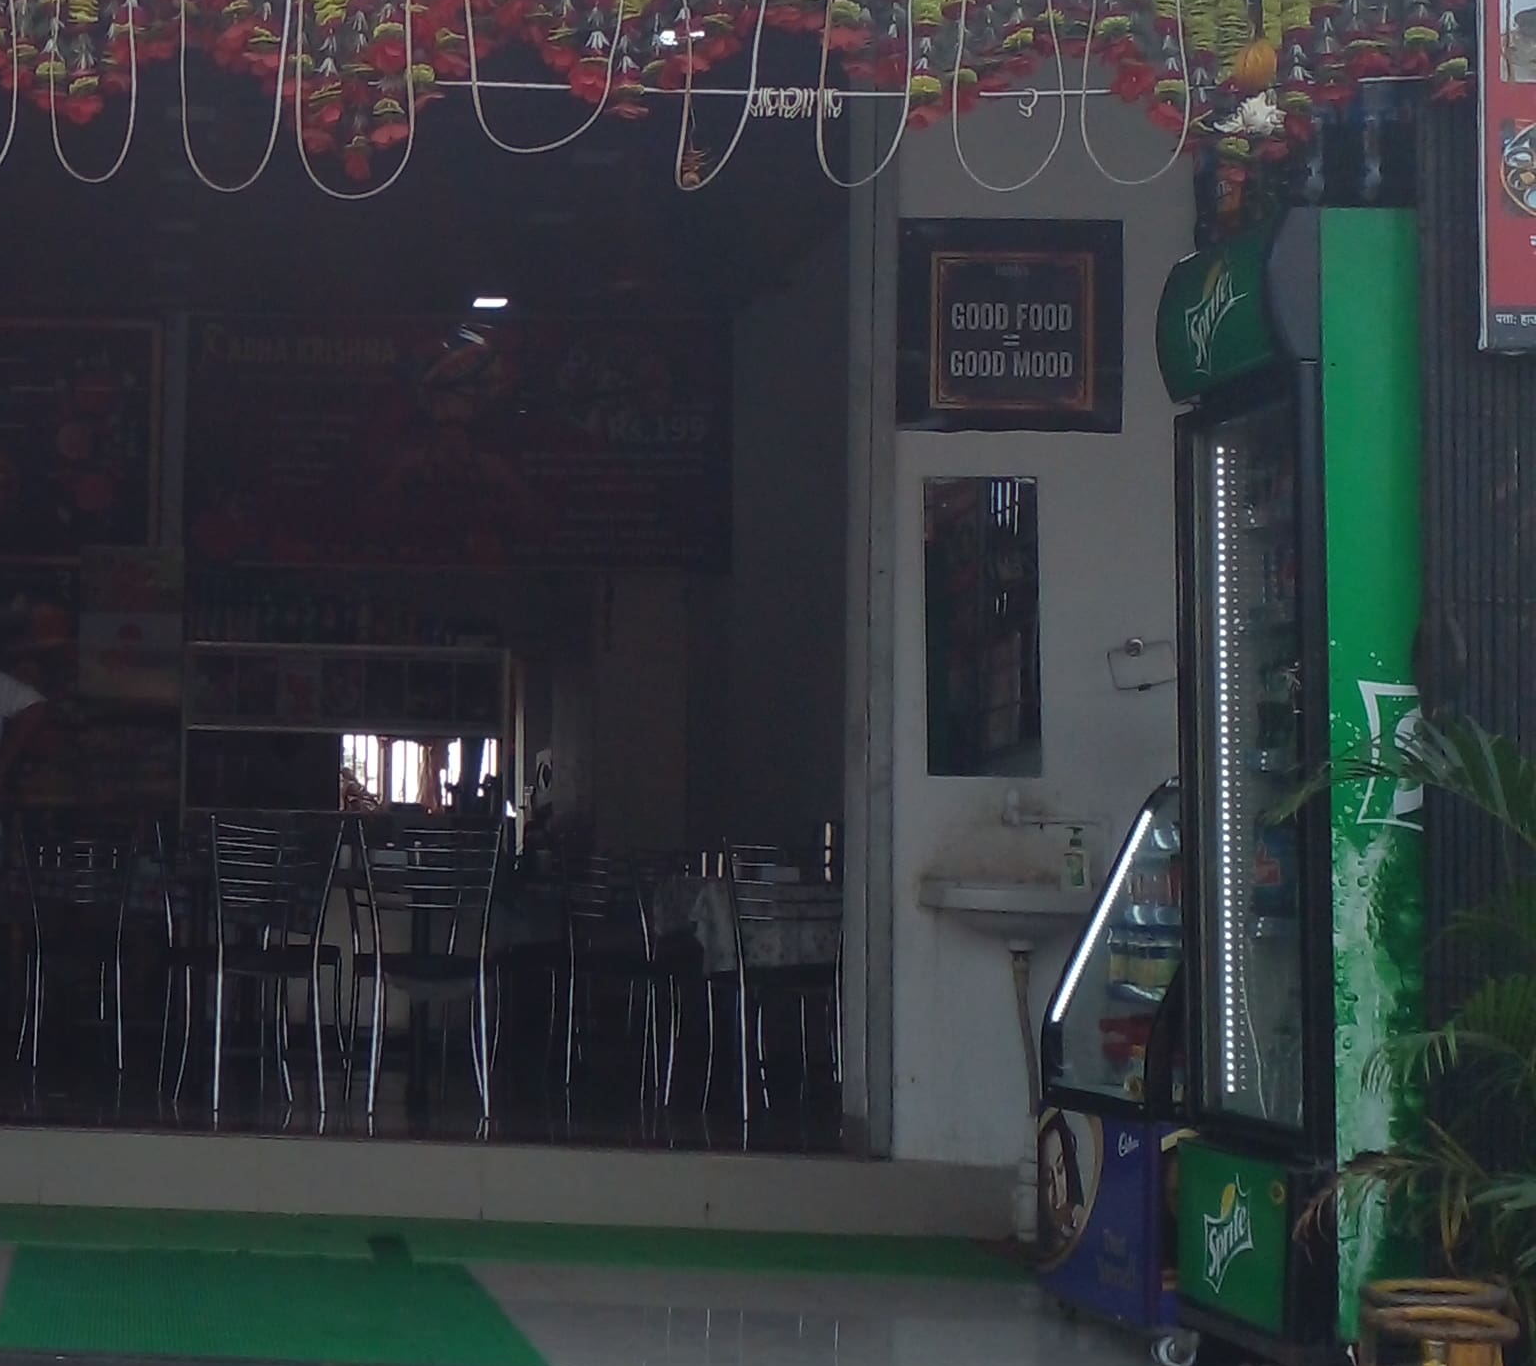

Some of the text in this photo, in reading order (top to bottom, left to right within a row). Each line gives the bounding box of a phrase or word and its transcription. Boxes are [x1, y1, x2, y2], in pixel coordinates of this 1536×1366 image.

[951, 302, 1073, 332] GOOD FOOD
[950, 350, 1074, 379] GOOD MOOD
[1208, 1204, 1247, 1278] Sprite
